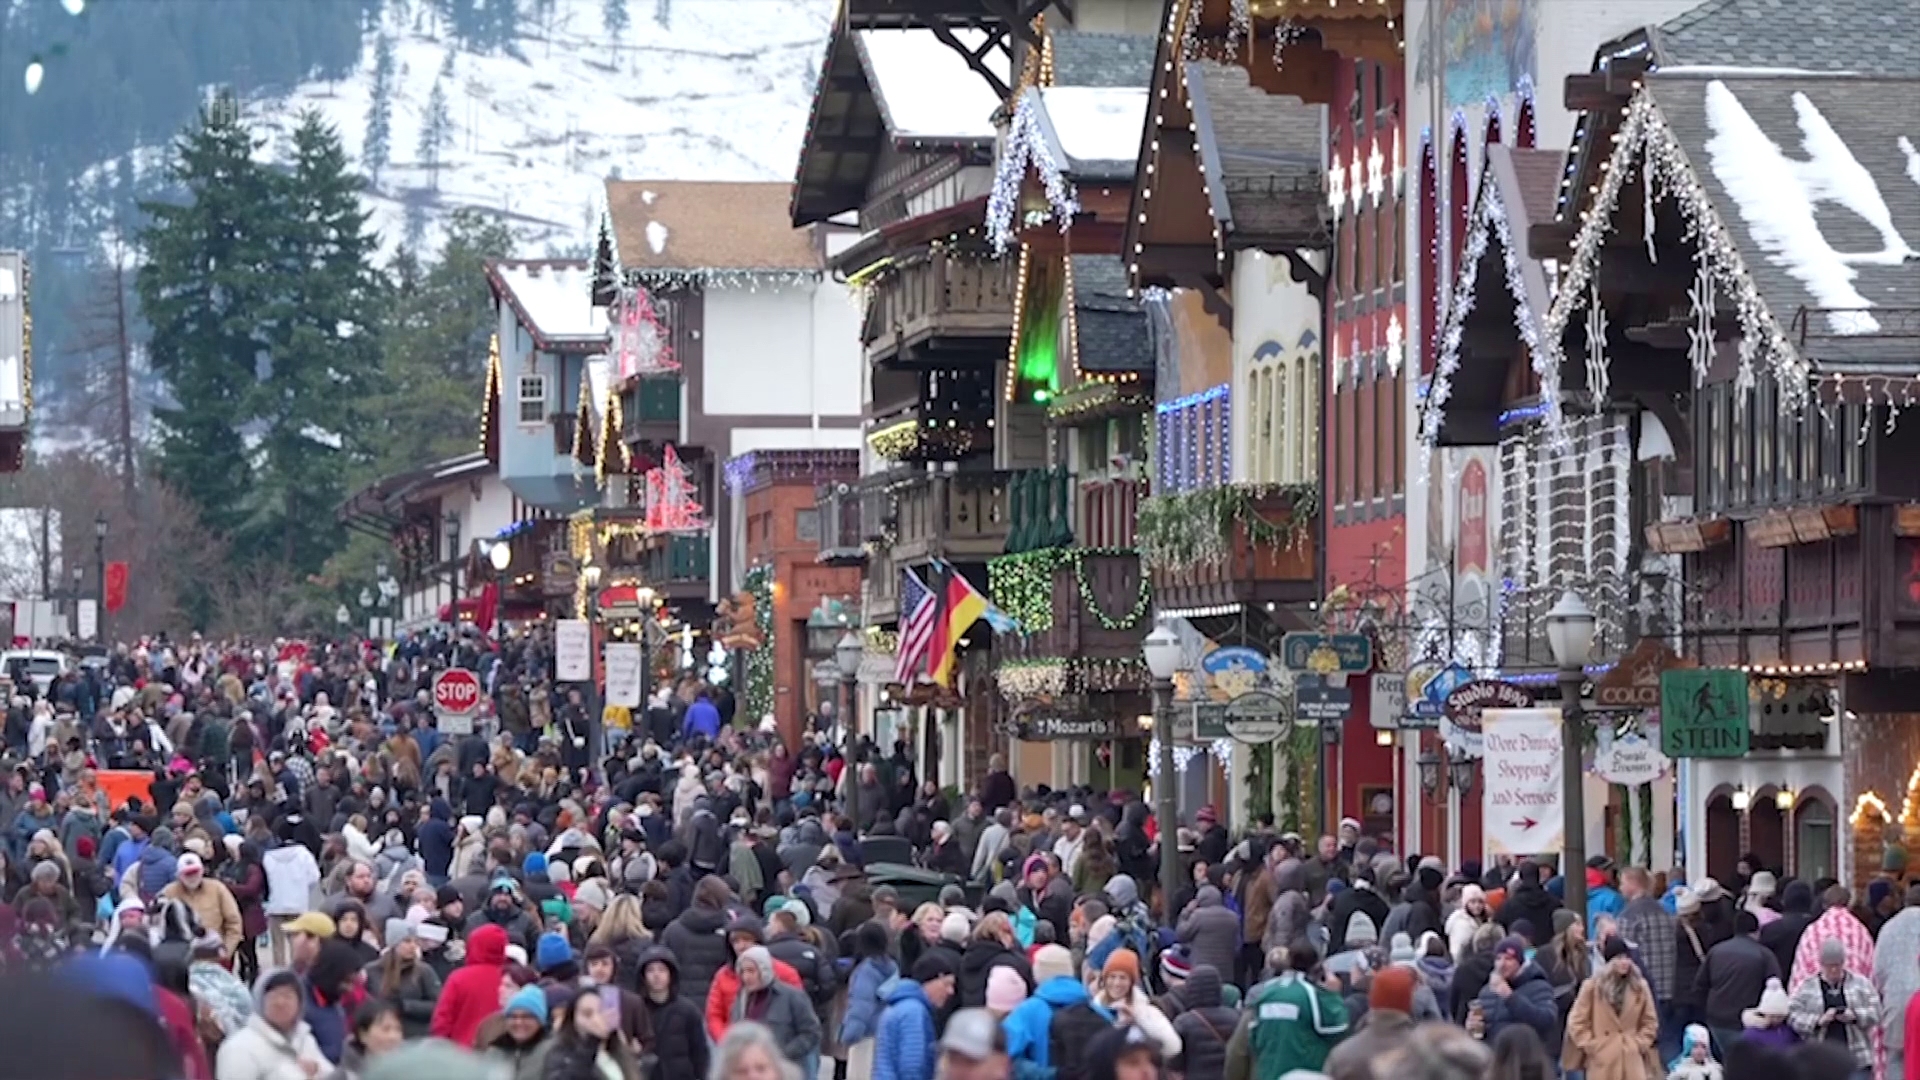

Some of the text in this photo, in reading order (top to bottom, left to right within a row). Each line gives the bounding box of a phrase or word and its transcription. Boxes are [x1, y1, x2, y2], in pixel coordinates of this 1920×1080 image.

[437, 682, 476, 700] STOP
[1448, 682, 1496, 711] Studio
[1487, 733, 1517, 752] More
[1672, 727, 1741, 750] STEIN
[1498, 760, 1551, 782] Shopping
[1491, 787, 1557, 806] and Services
